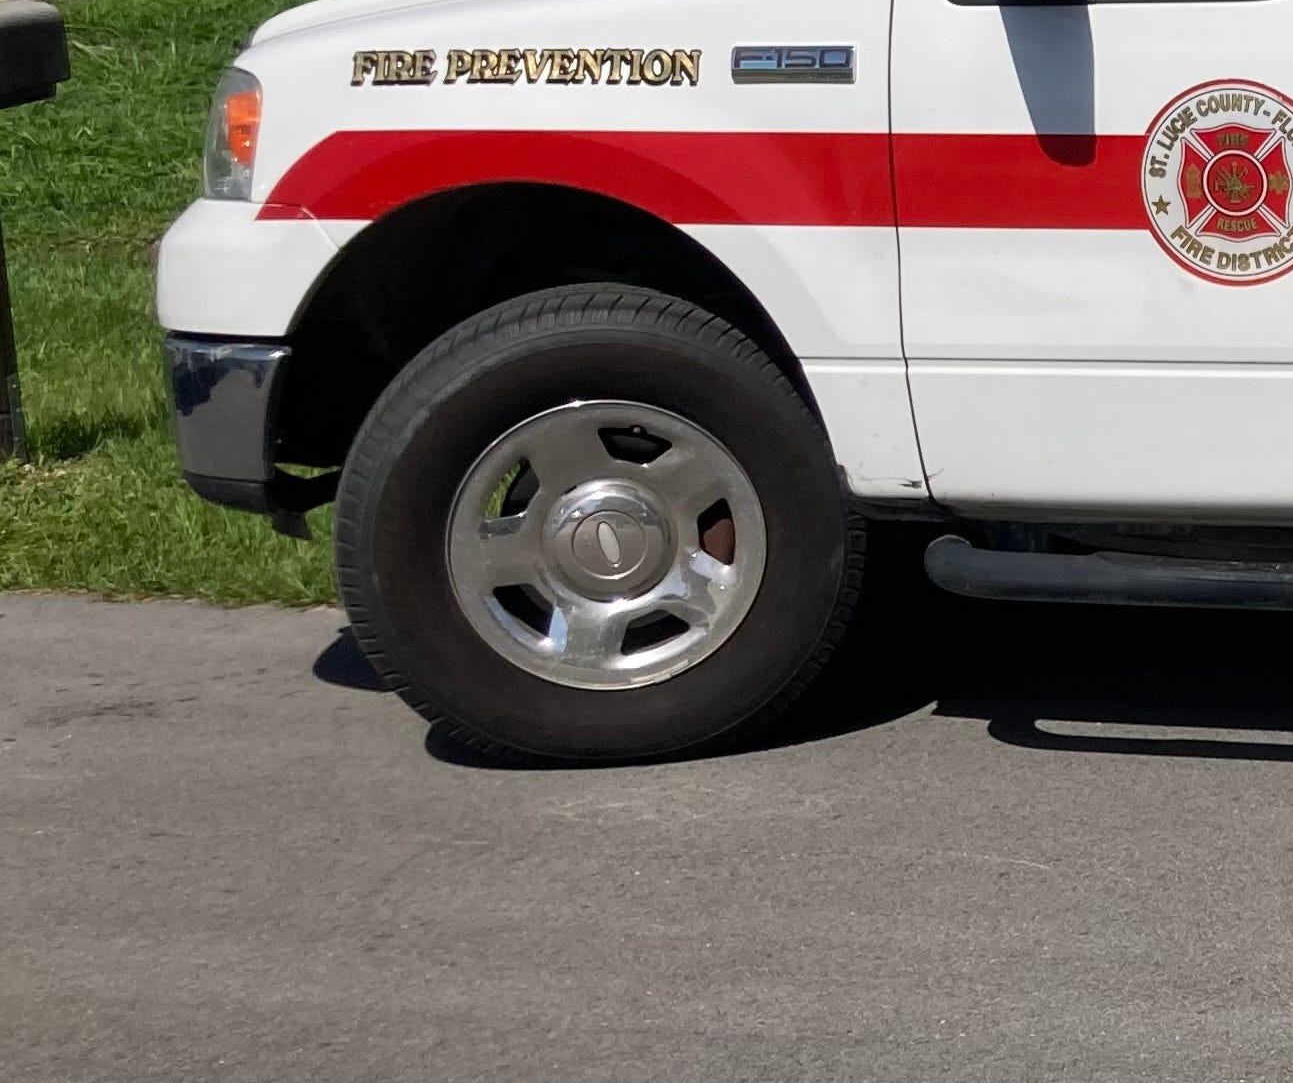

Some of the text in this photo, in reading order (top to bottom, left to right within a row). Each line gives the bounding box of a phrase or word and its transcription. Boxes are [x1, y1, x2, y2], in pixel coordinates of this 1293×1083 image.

[350, 46, 702, 87] FIRE PREVENTION
[1156, 107, 1198, 151] LUCIE
[1148, 154, 1170, 179] ST.
[1170, 225, 1216, 266] FIRE
[1217, 218, 1258, 232] RESCUE
